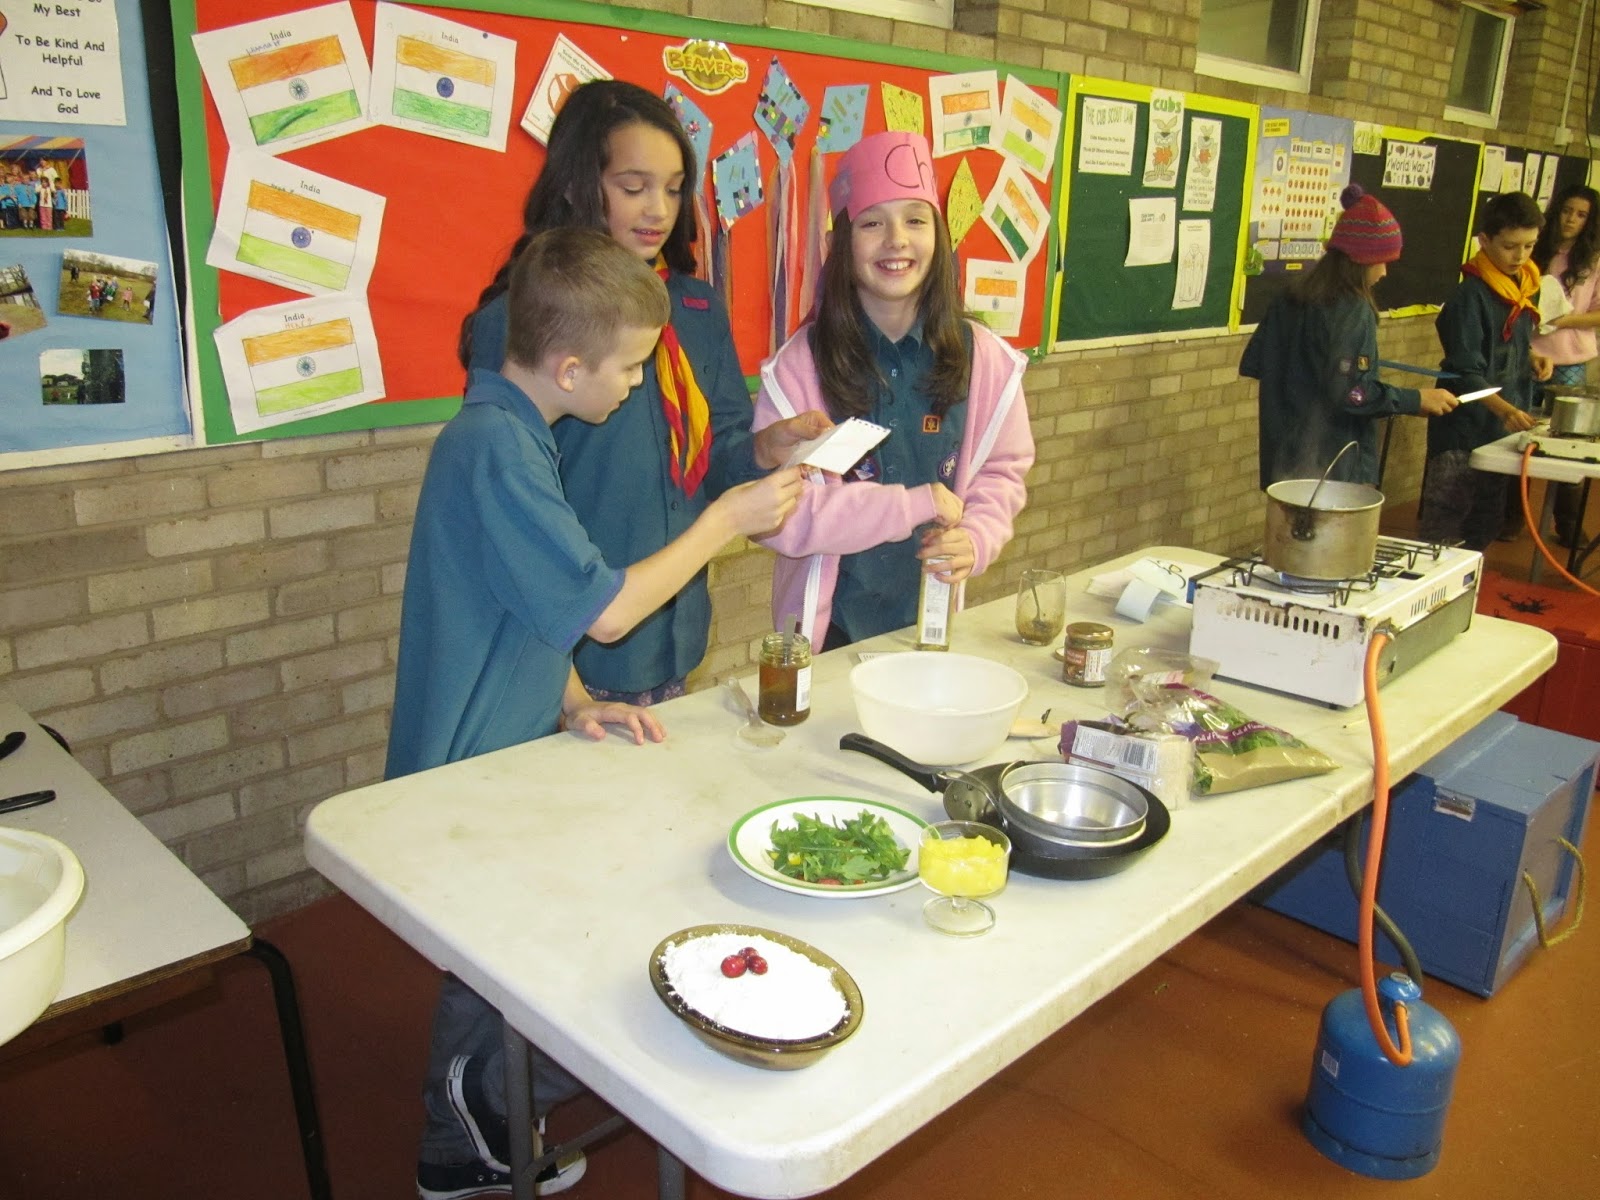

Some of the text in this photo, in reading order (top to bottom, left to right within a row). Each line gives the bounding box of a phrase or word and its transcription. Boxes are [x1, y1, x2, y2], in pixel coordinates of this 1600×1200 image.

[34, 4, 80, 17] My Best
[270, 30, 292, 40] India
[441, 32, 458, 44] India
[15, 34, 104, 52] To Be Kind And
[43, 53, 82, 67] Helpful
[667, 49, 746, 79] BEAVERS
[32, 86, 100, 99] And To Love
[58, 104, 78, 114] God
[1153, 96, 1182, 114] cubs
[1390, 158, 1410, 172] World
[1412, 161, 1424, 172] War
[300, 180, 320, 194] India
[284, 312, 304, 322] India
